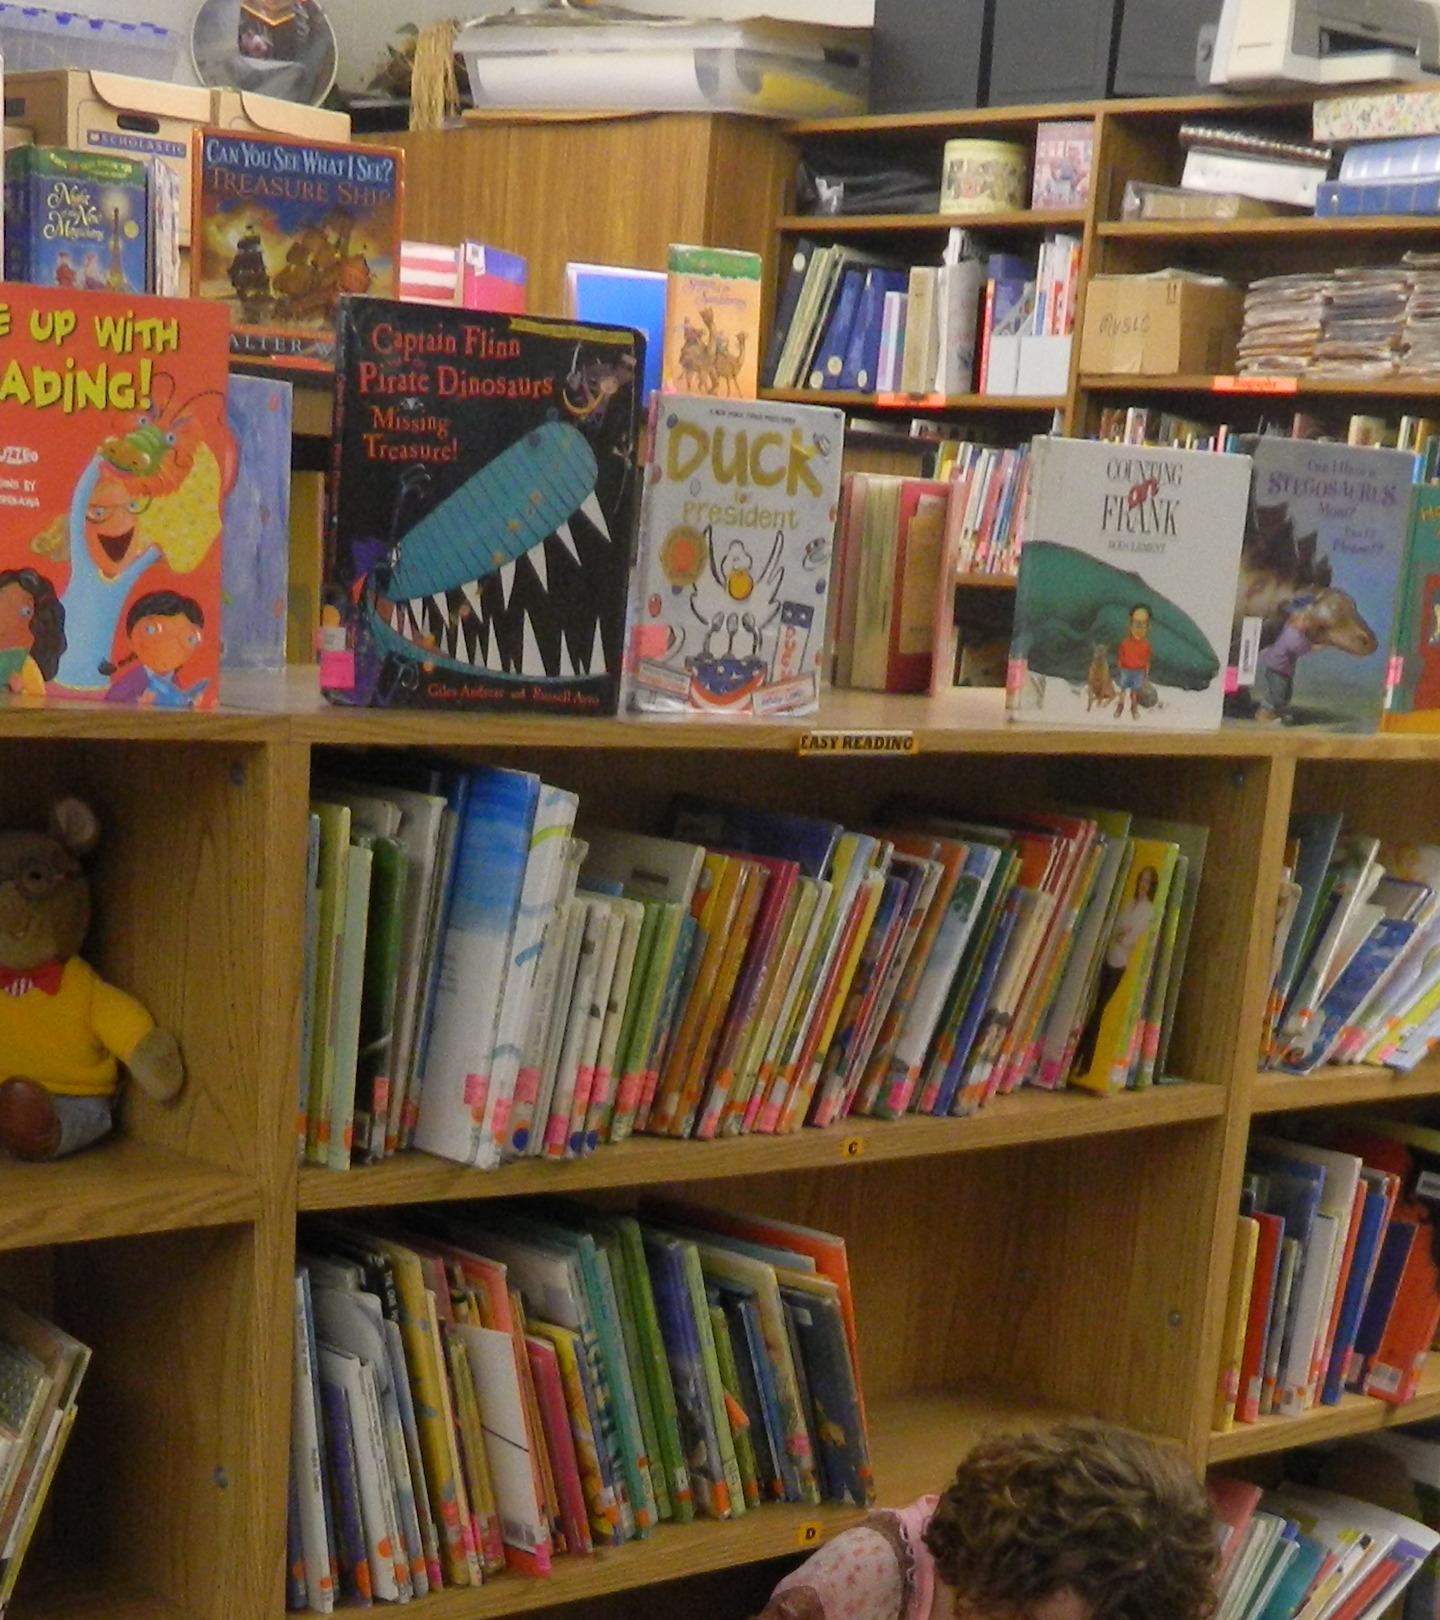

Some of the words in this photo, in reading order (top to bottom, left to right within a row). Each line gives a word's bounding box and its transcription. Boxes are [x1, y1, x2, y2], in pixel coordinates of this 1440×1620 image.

[100, 136, 185, 156] SCHOLASTIC
[208, 167, 329, 202] TREASURE
[337, 181, 392, 207] SHIP
[29, 308, 78, 341] UP
[94, 310, 180, 355] WITH
[371, 322, 458, 364] Captain
[463, 324, 522, 361] Flinn
[359, 361, 431, 396] Pirate
[436, 365, 555, 399] Dinosaurs
[370, 404, 452, 441] Missing
[362, 432, 459, 463] Treasure!
[1106, 456, 1184, 487] COUNTING
[1100, 492, 1181, 537] FRANK
[801, 735, 840, 750] EASY
[842, 736, 914, 751] READING
